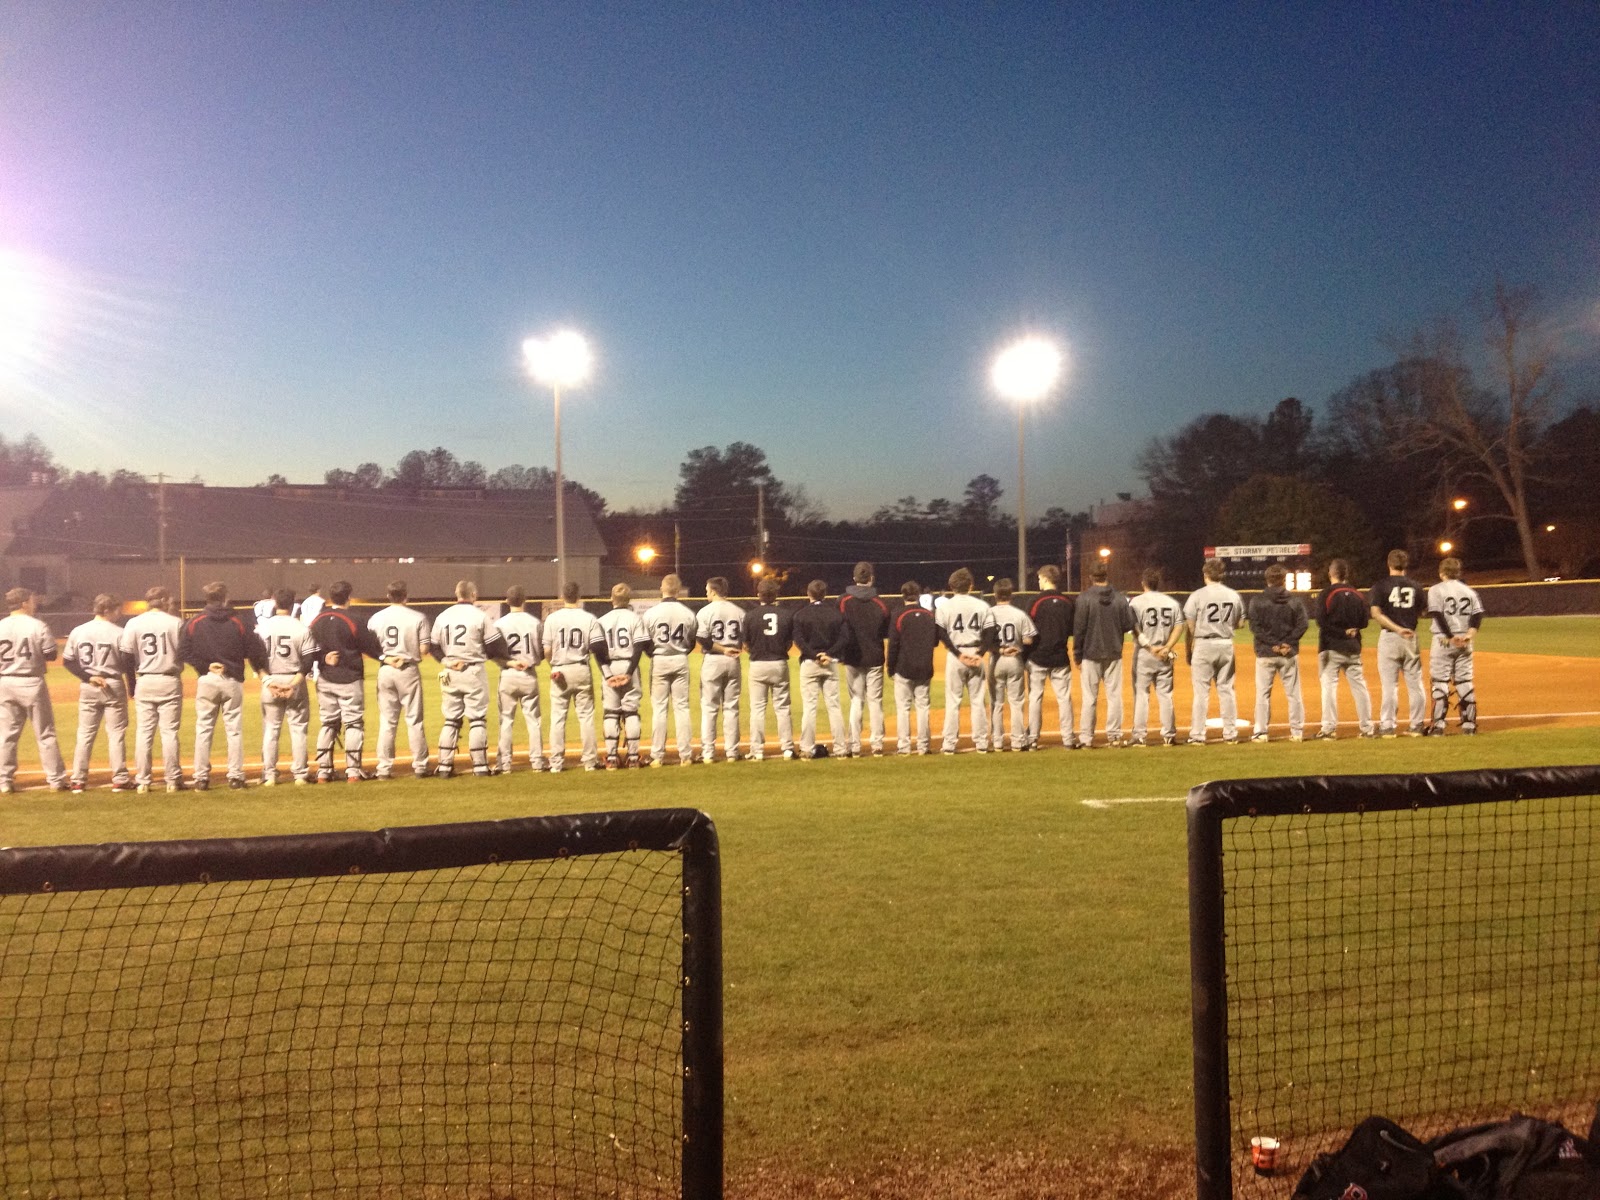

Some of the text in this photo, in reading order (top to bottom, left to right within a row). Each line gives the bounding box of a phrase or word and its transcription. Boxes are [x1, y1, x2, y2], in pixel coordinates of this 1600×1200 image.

[1234, 547, 1262, 555] STORMY
[1266, 546, 1296, 554] PETRELS
[1388, 586, 1416, 609] 43
[1444, 596, 1471, 616] 32
[952, 612, 980, 633] 44
[1145, 607, 1172, 627] 35
[1206, 602, 1234, 622] 27
[444, 624, 467, 646] 12
[656, 622, 685, 644] 34
[711, 619, 740, 641] 33
[763, 613, 778, 636] 3
[141, 632, 168, 656] 31
[266, 635, 291, 657] 15
[385, 625, 399, 648] 9
[508, 632, 531, 655] 21
[559, 627, 583, 649] 10
[607, 627, 630, 648] 16
[0, 637, 32, 662] 24
[79, 642, 112, 666] 37
